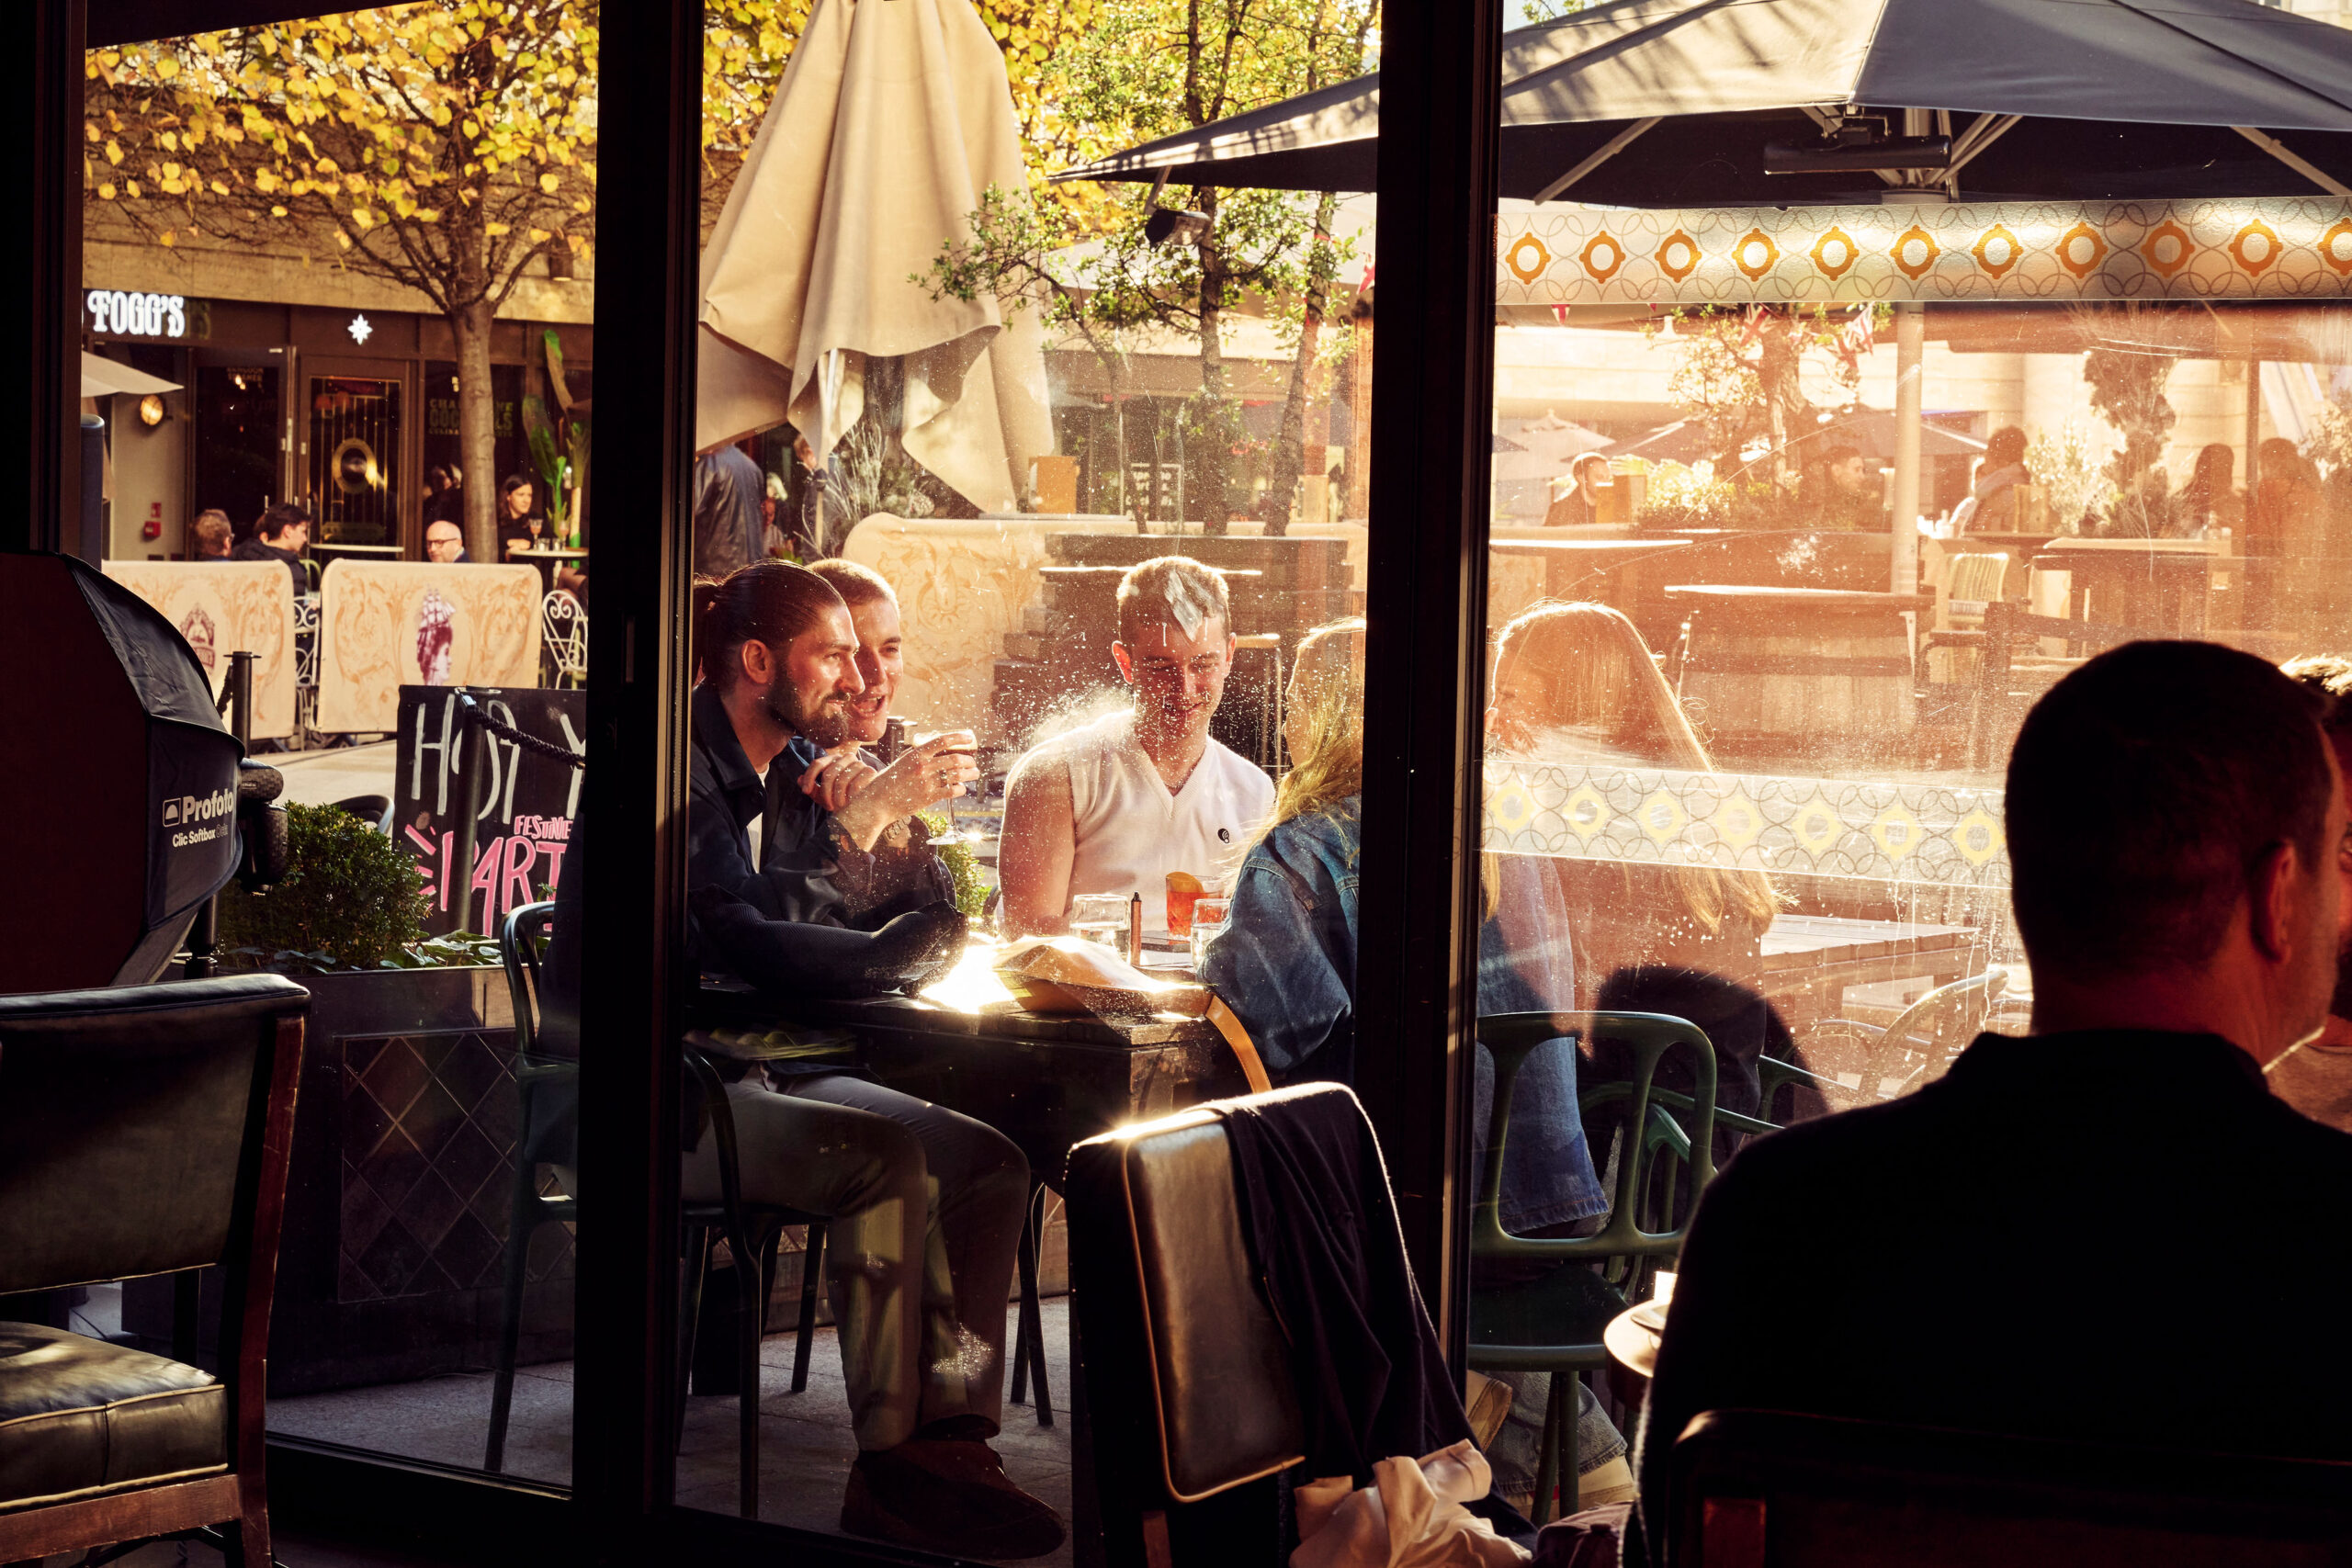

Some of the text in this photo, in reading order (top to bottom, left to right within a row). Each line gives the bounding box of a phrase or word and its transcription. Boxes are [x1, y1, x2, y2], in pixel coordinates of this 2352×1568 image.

[87, 290, 186, 338] FOGG'S
[182, 789, 233, 823] Profoto
[172, 830, 189, 848] Clic
[188, 828, 215, 843] Softbox
[514, 815, 574, 840] FESTIVE
[440, 831, 568, 939] PART
